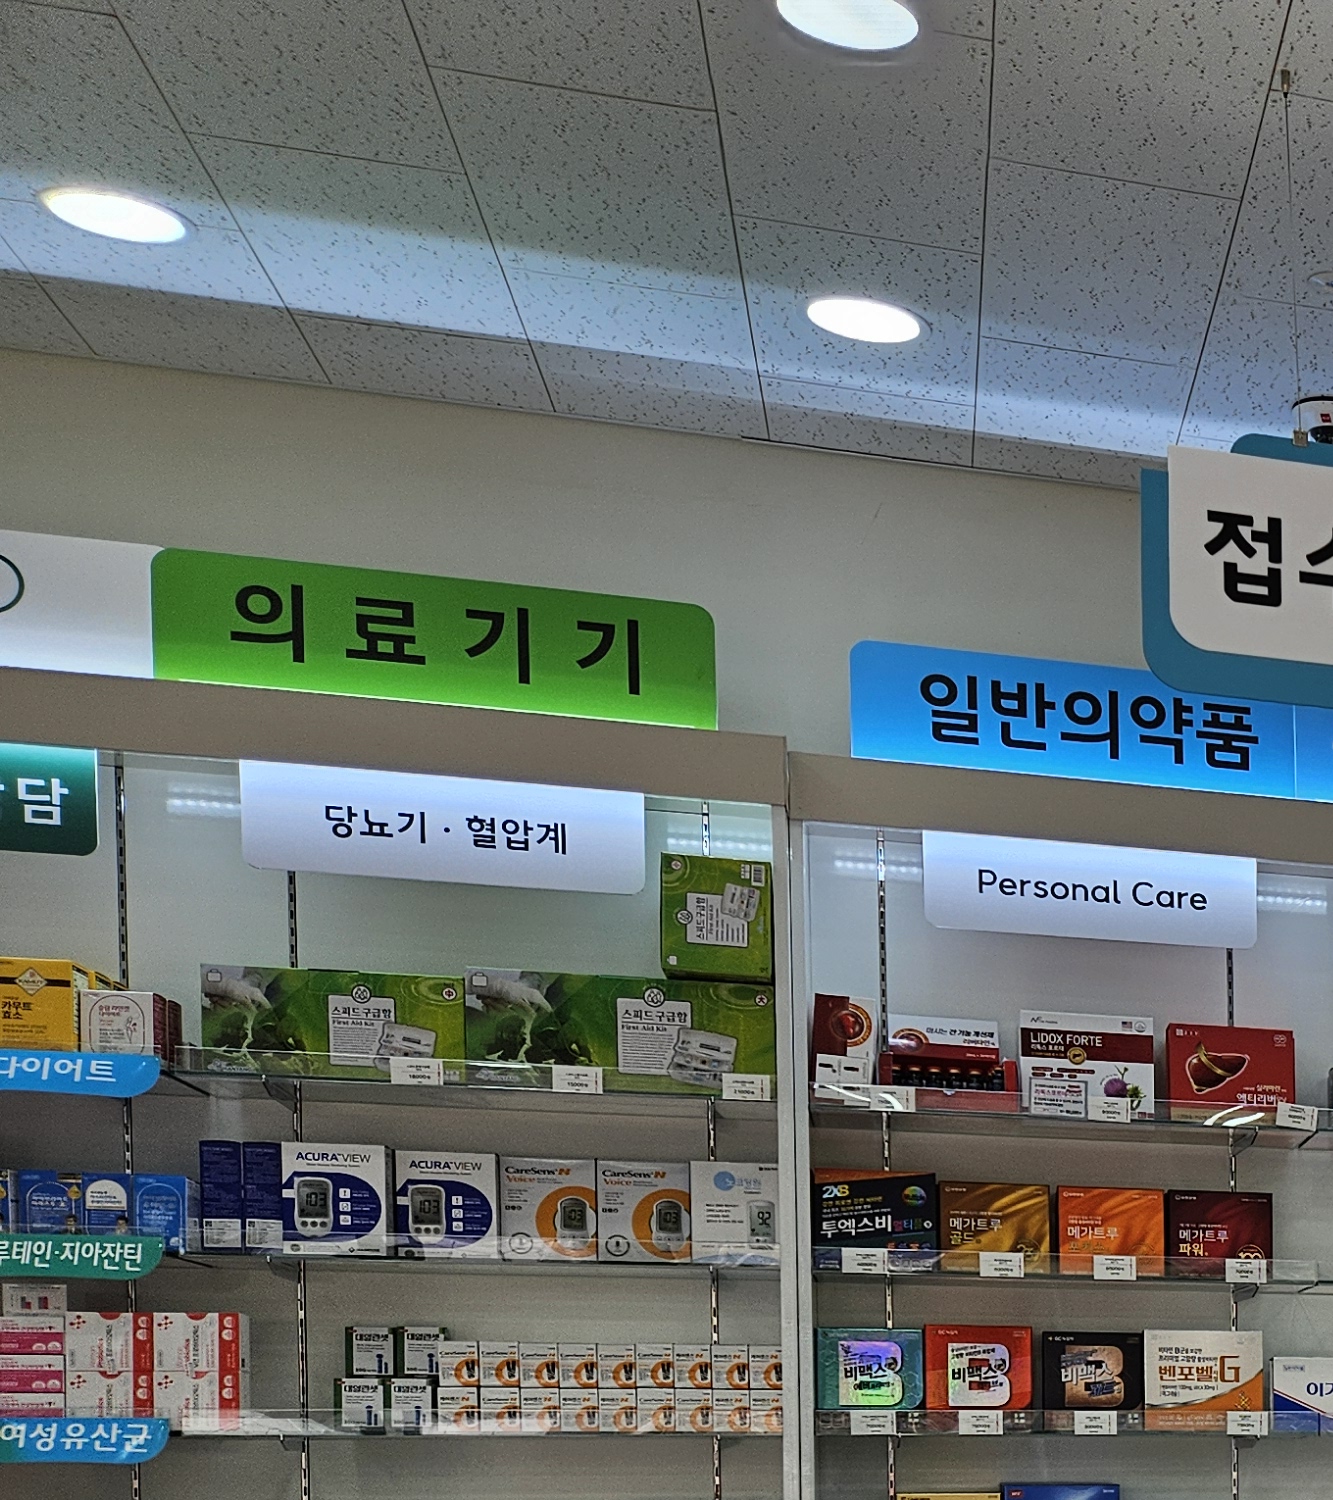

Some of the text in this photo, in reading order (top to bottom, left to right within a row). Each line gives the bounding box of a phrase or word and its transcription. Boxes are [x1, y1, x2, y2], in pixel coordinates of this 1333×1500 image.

[917, 672, 1261, 769] 일반의약품
[0, 777, 69, 828] 담
[323, 804, 568, 856] 당뇨기 혈압계
[977, 868, 1208, 914] Personal Care
[622, 1009, 687, 1023] 스피드 구급함
[1030, 1032, 1103, 1047] LIDOX FORTE
[505, 1166, 557, 1176] CareSens
[506, 1175, 535, 1183] Voice
[602, 1169, 653, 1179] CareSens
[603, 1178, 631, 1186] Voice
[820, 1214, 892, 1238] 투엑스비
[950, 1218, 1002, 1231] 메가트루
[1067, 1226, 1119, 1240] 메가트루
[1179, 1229, 1229, 1243] 메가트루
[843, 1364, 887, 1382] 비맥스
[951, 1367, 998, 1384] 비맥스
[1061, 1365, 1114, 1385] 비맥스
[1158, 1365, 1213, 1382] 벤포벨
[1, 1422, 152, 1452] 여성유산균
